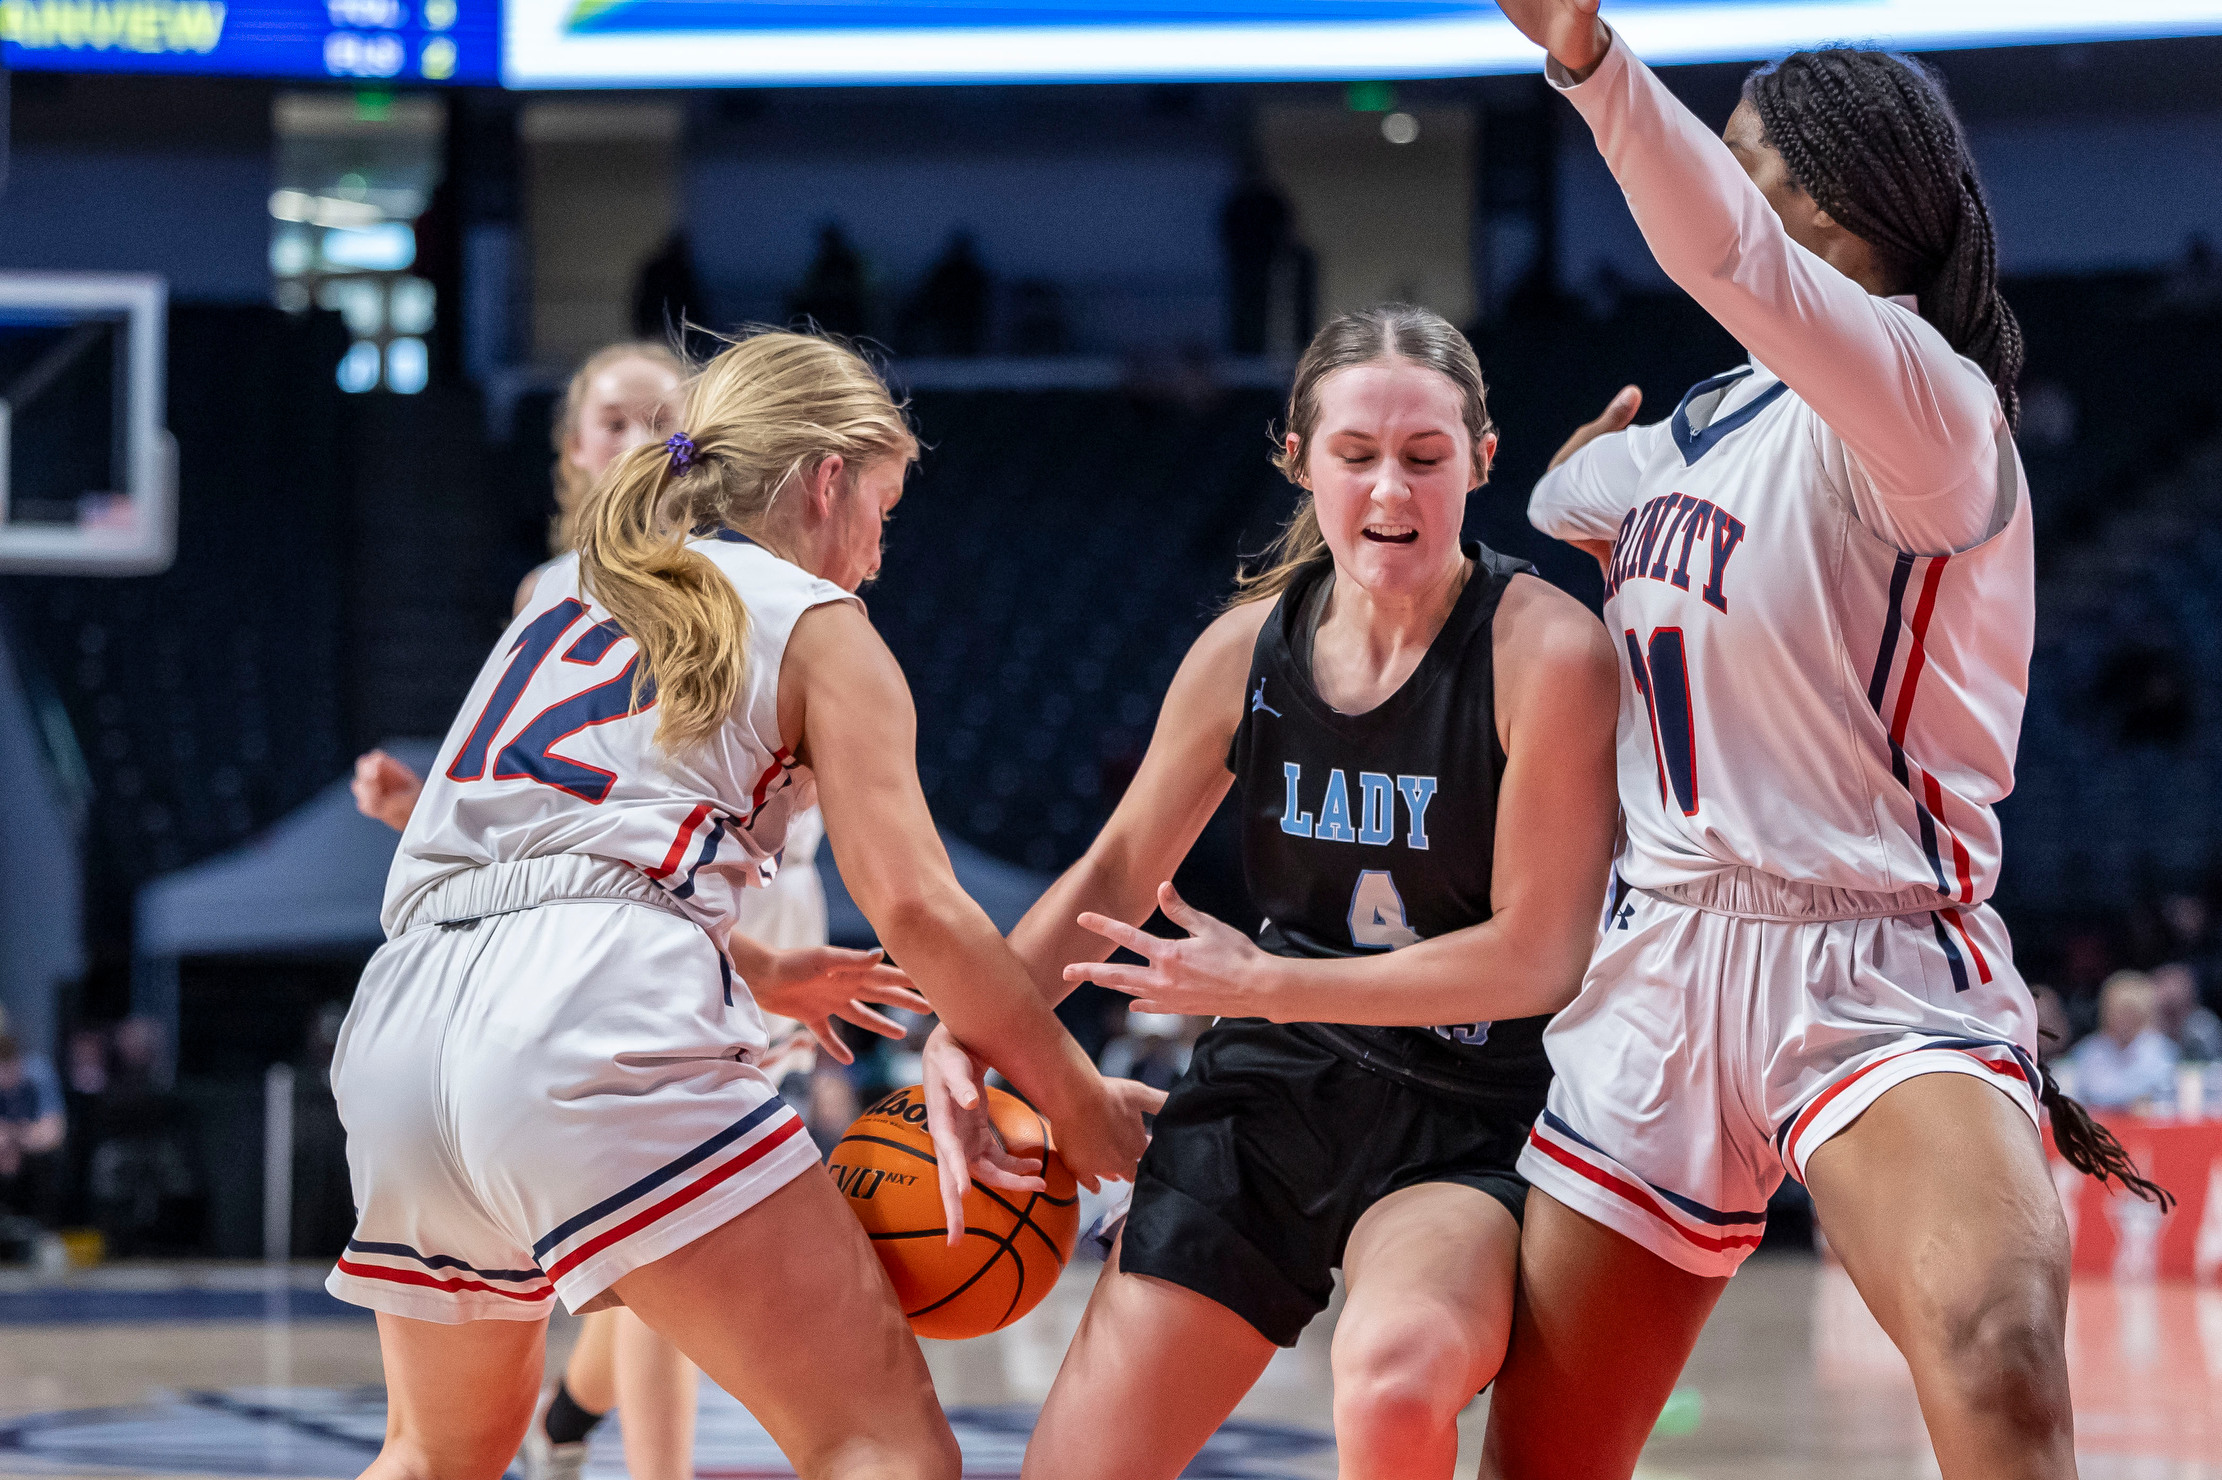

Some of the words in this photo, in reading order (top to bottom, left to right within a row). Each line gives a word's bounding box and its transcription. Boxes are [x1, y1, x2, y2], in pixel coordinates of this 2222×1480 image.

[1604, 492, 1746, 615] RINITY
[446, 597, 660, 804] 12
[1280, 762, 1438, 850] LADY
[1347, 869, 1425, 952] 4
[884, 1171, 919, 1187] NXT
